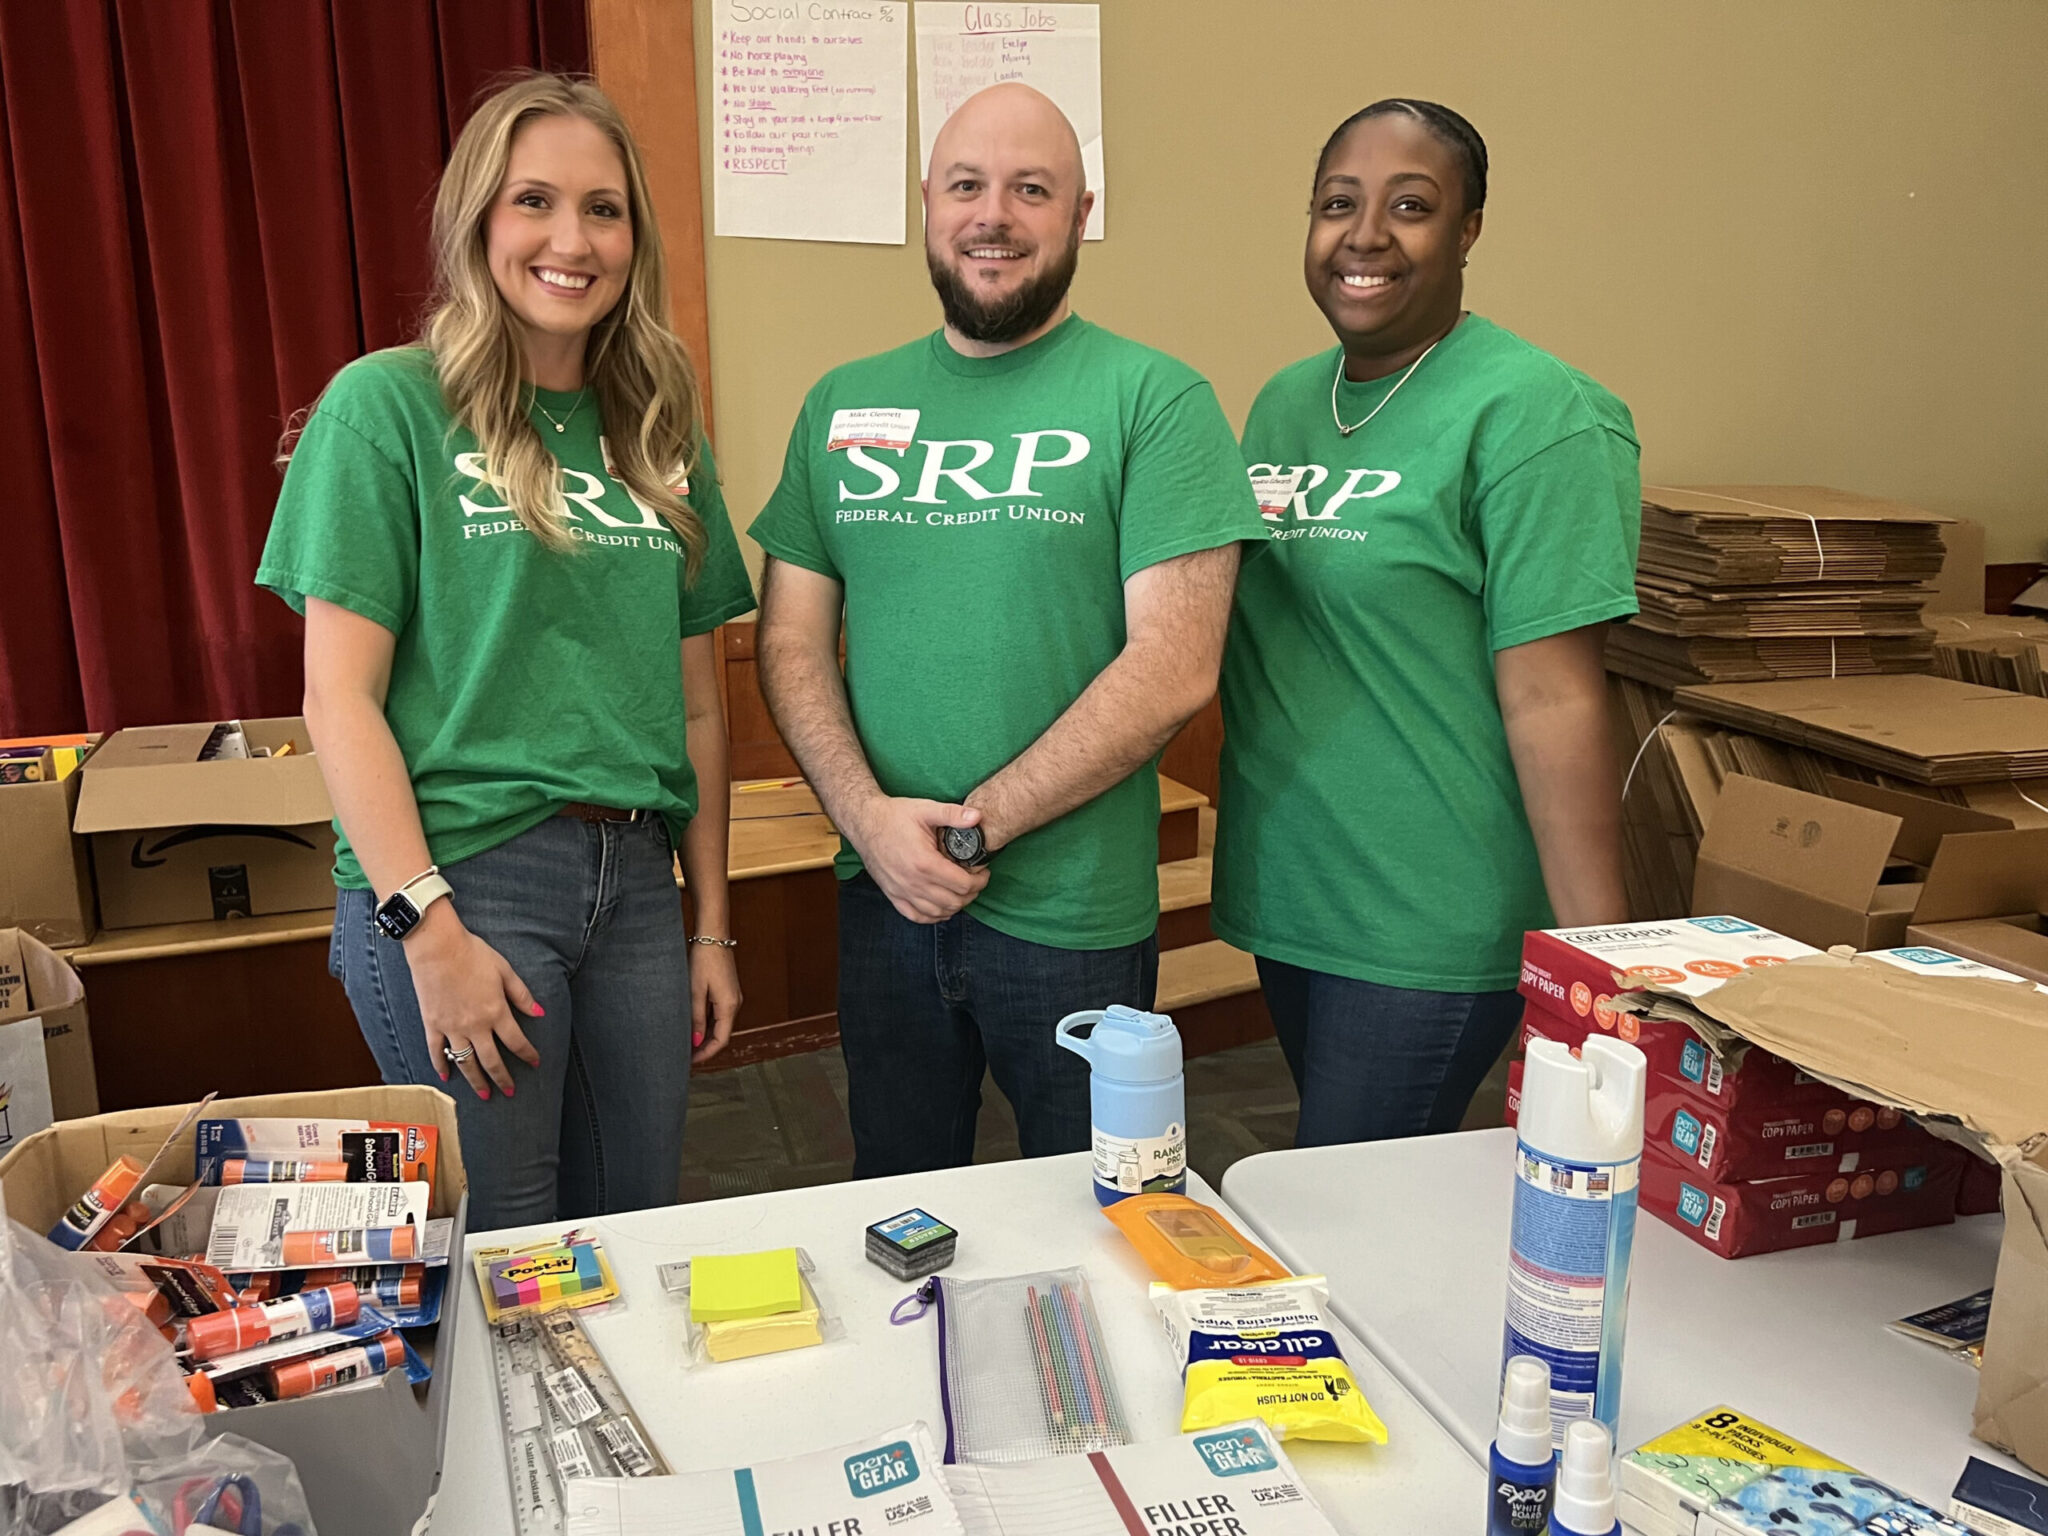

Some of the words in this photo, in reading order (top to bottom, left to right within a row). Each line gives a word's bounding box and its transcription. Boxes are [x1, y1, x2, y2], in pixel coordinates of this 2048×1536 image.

[731, 0, 799, 22] Social
[808, 3, 872, 20] Contract
[965, 5, 1011, 31] Class
[1019, 7, 1057, 29] Jobs
[730, 31, 751, 46] Keep
[756, 34, 771, 44] our
[776, 33, 806, 44] hands
[812, 36, 820, 44] to
[823, 36, 863, 45] ourselves
[730, 51, 743, 61] No
[732, 67, 745, 77] Be
[770, 67, 779, 76] to
[783, 67, 824, 82] everyone
[732, 114, 755, 128] Stay
[769, 131, 788, 140] our
[733, 145, 747, 155] No
[732, 158, 788, 171] RESPECT
[839, 430, 1091, 505] SRP
[454, 452, 672, 532] SR
[835, 508, 918, 525] FEDERAL
[925, 508, 1000, 526] CREDIT
[1007, 504, 1085, 525] UNION
[462, 518, 531, 540] FEDE
[569, 526, 640, 549] CREDIT
[646, 536, 685, 559] UNI
[1308, 526, 1369, 542] UNION
[1565, 930, 1618, 945] COPY
[1619, 926, 1679, 942] PAPER
[1699, 963, 1715, 973] 24
[1521, 968, 1540, 989] COPY
[1538, 976, 1565, 1000] PAPER
[1683, 1055, 1699, 1076] GEAR
[1675, 1115, 1694, 1132] pen
[1762, 1127, 1785, 1139] COPY
[1785, 1124, 1815, 1137] PAPER
[304, 1124, 313, 1147] PURPLE
[1676, 1127, 1696, 1149] GEAR
[364, 1137, 377, 1170] School
[406, 1128, 417, 1162] ELMER'S
[1166, 1154, 1182, 1167] PRO
[387, 1186, 401, 1218] ELMER'S
[1682, 1187, 1701, 1204] pen
[1770, 1199, 1792, 1211] COPY
[1792, 1193, 1820, 1206] PAPER
[1682, 1198, 1703, 1221] GEAR
[508, 1256, 570, 1278] Post-it
[1190, 1315, 1232, 1326] Wipes
[1236, 1314, 1320, 1328] Disinfecting
[1240, 1330, 1265, 1338] wipes
[1208, 1337, 1281, 1355] clear
[1283, 1336, 1323, 1354] all
[1257, 1392, 1287, 1406] FLUSH
[1288, 1392, 1309, 1403] NOT
[1312, 1392, 1325, 1401] DO
[1705, 1413, 1739, 1429] 8
[1736, 1424, 1797, 1456] INDIVIDUAL
[1725, 1429, 1765, 1449] PACKS
[525, 1441, 536, 1468] Shatter
[1199, 1437, 1245, 1460] pen
[1728, 1439, 1767, 1461] TISSUES
[849, 1452, 894, 1480] pen
[1213, 1447, 1266, 1471] GEAR
[859, 1460, 910, 1491] GEAR
[528, 1466, 542, 1508] Resistant
[1251, 1487, 1272, 1495] Made
[1281, 1482, 1295, 1490] the
[1497, 1482, 1547, 1504] EXPO
[884, 1501, 906, 1513] Made
[915, 1494, 929, 1503] the
[1253, 1491, 1285, 1502] USA
[886, 1506, 916, 1522] USA
[1143, 1494, 1236, 1526] FILLER
[1511, 1511, 1542, 1520] BOARD
[1512, 1502, 1542, 1513] WHITE
[772, 1518, 863, 1536] LER
[1511, 1518, 1540, 1529] CARE
